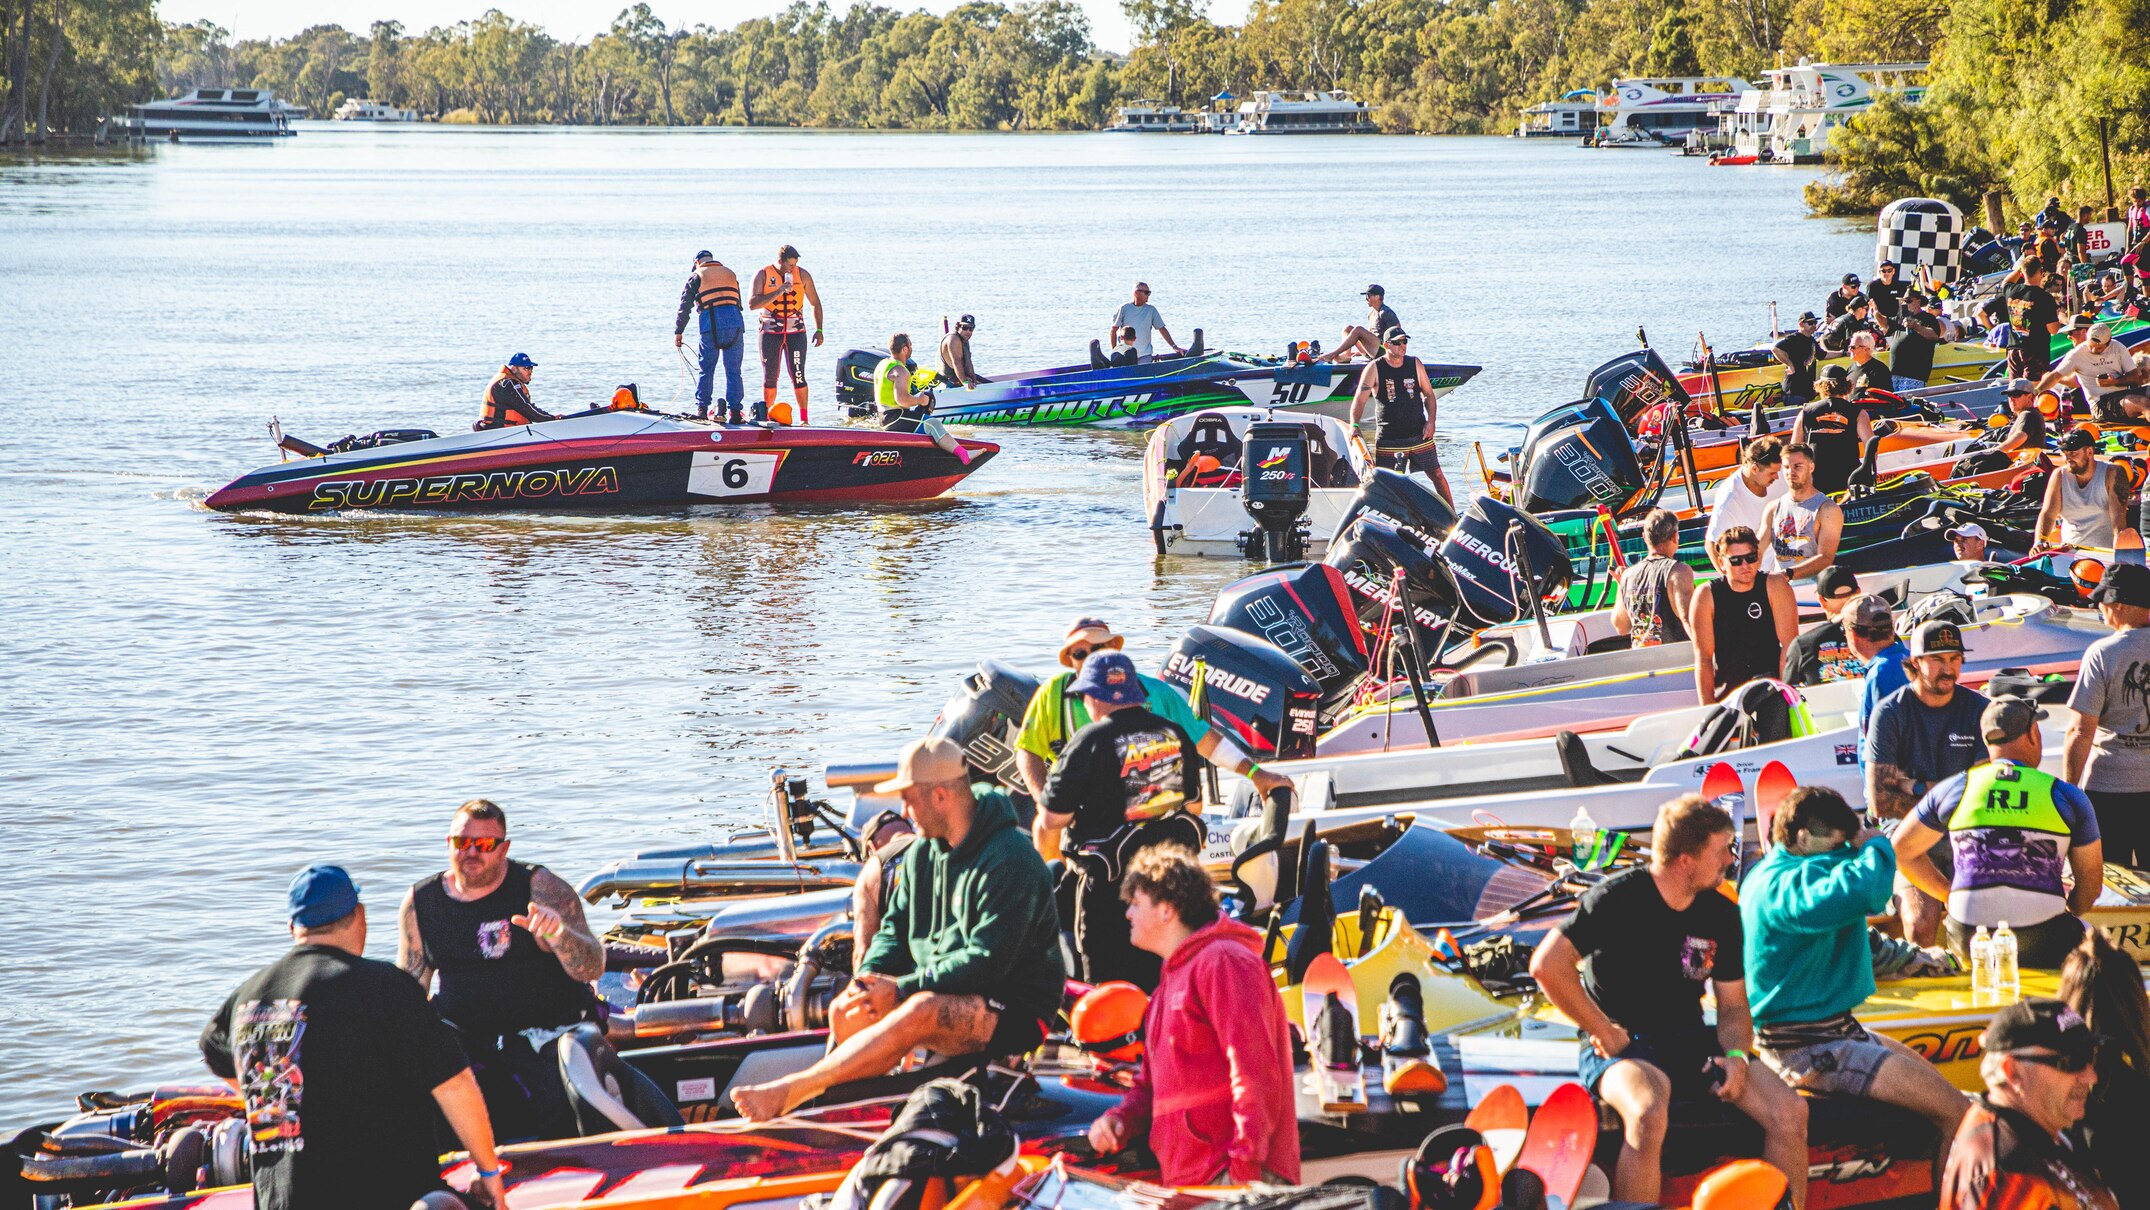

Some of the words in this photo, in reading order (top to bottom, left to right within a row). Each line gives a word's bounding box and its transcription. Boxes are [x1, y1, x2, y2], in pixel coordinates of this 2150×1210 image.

[2084, 239, 2111, 250] SED
[2086, 230, 2105, 240] ER
[793, 350, 803, 384] BRICK
[1270, 382, 1312, 405] 50
[1030, 393, 1152, 423] DUTY
[722, 458, 749, 489] 6
[1554, 443, 1616, 501] 300
[308, 466, 619, 510] SUPERNOVA
[1843, 502, 1912, 519] HITTLESEA
[1451, 529, 1542, 581] MERCU
[1168, 652, 1271, 704] EVNRUDE
[1291, 719, 1314, 733] 250
[1987, 789, 2029, 810] RJ
[1208, 831, 1231, 844] Cho
